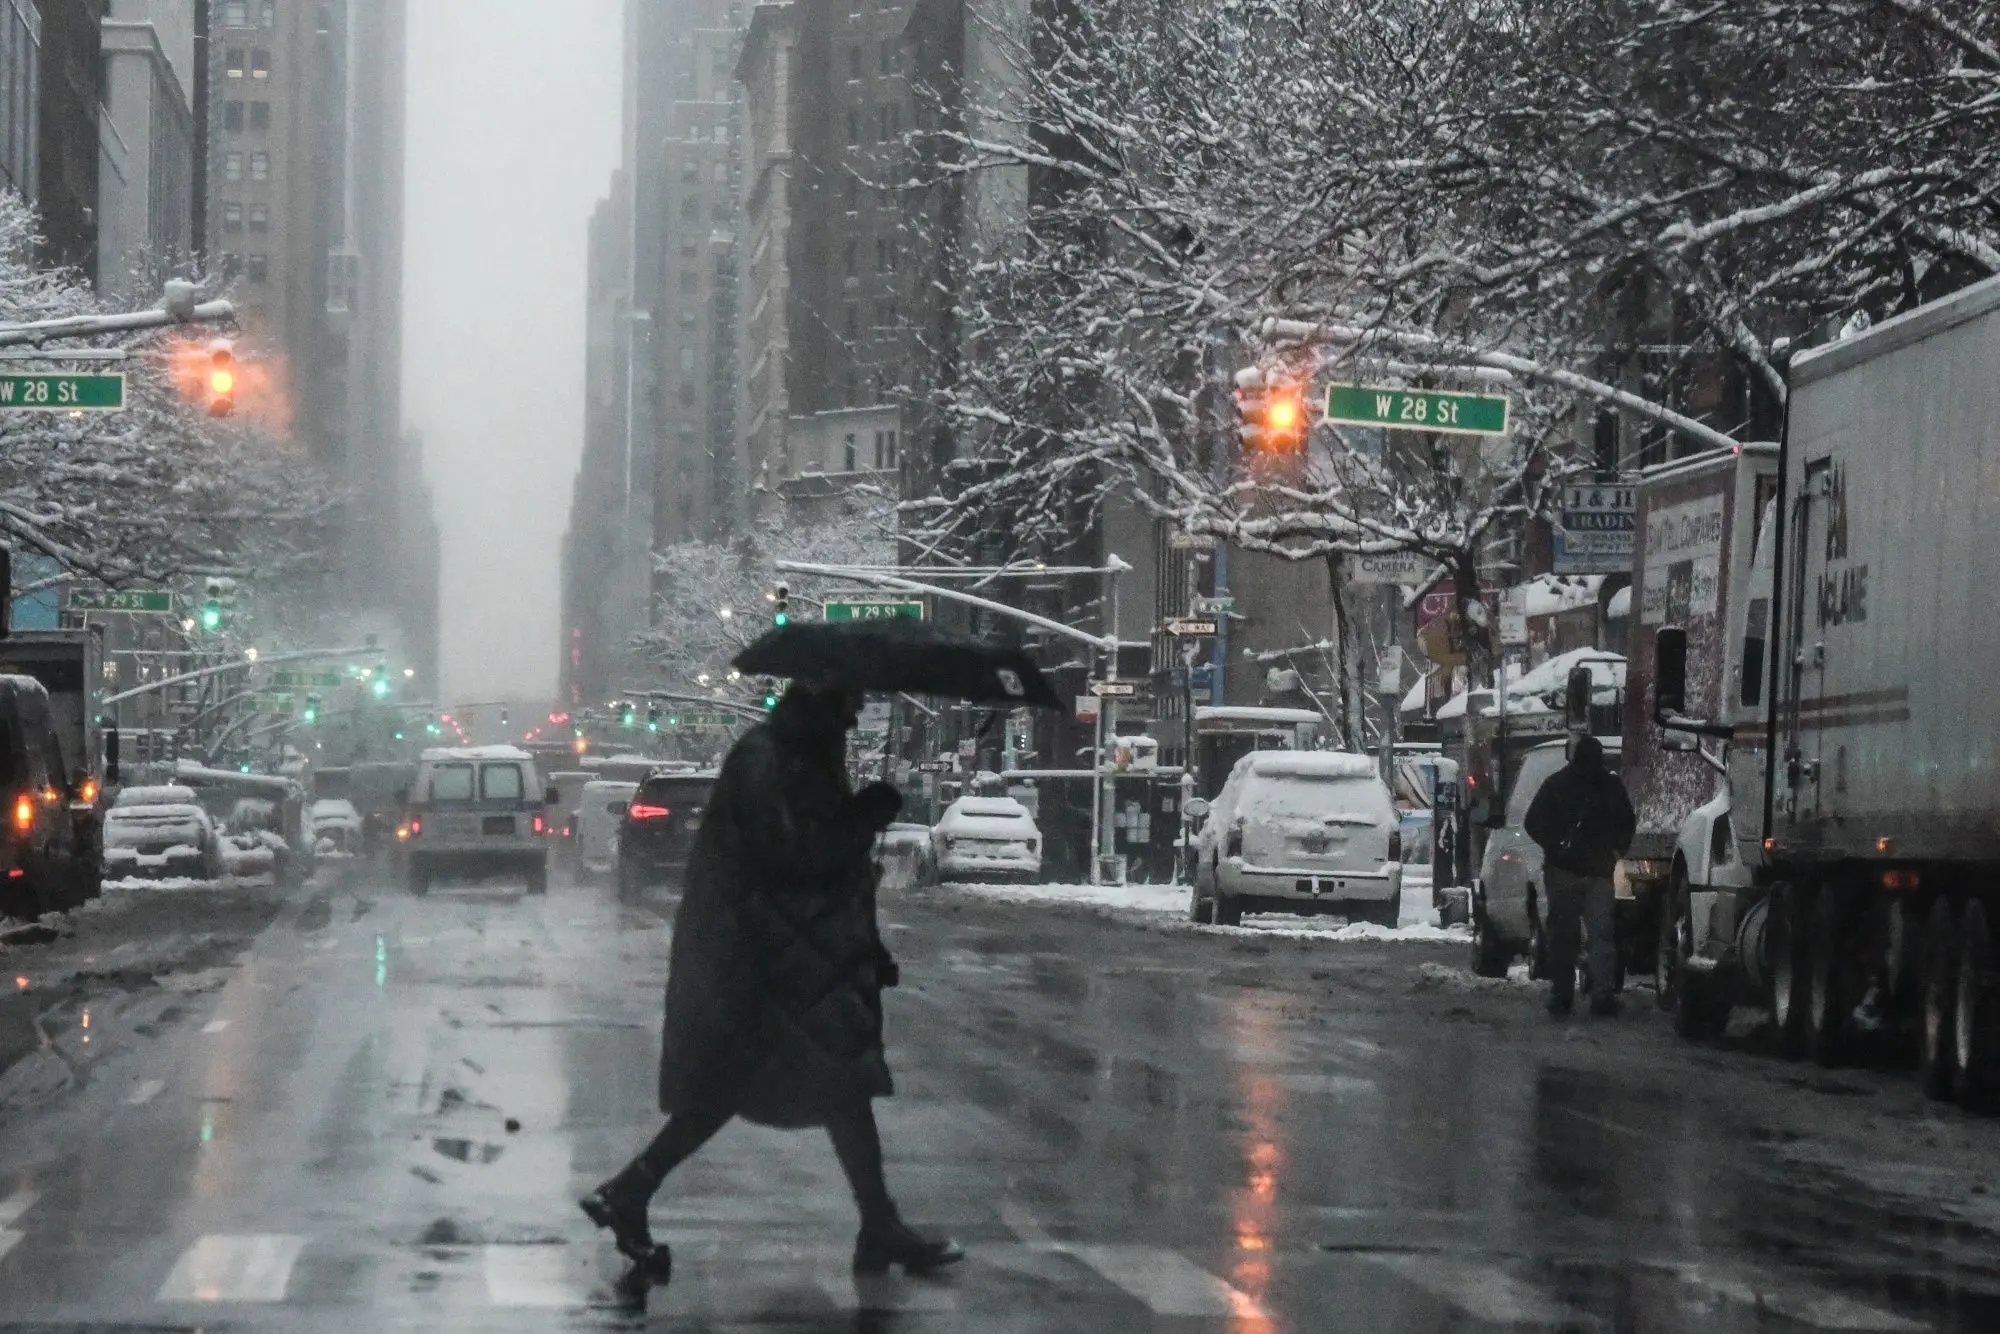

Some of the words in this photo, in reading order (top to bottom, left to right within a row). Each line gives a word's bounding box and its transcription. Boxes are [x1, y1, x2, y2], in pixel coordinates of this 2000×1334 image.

[0, 381, 15, 402] W
[23, 380, 49, 402] 28
[58, 380, 78, 402] St
[1376, 394, 1392, 418] W
[1400, 397, 1428, 421] 28
[1436, 400, 1460, 423] St
[850, 605, 860, 619] W
[864, 605, 881, 619] 29
[884, 605, 896, 618] St
